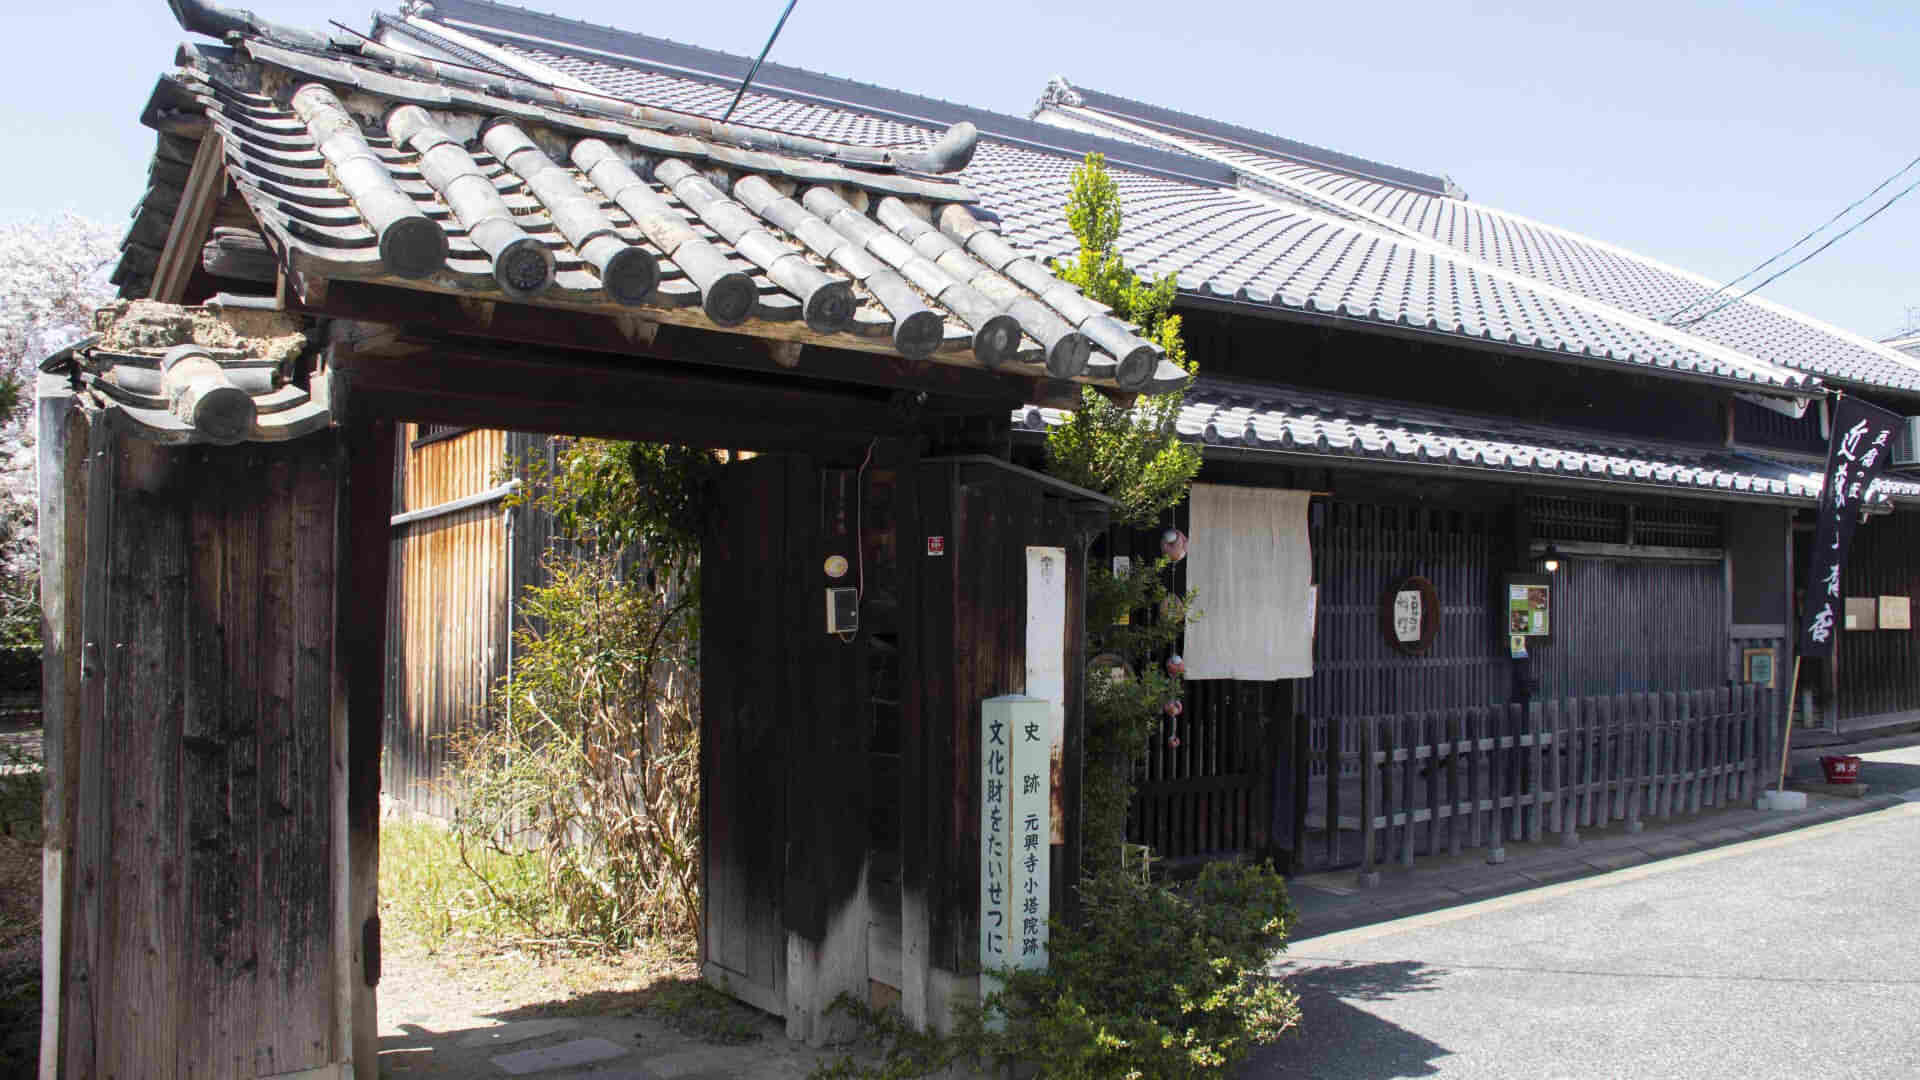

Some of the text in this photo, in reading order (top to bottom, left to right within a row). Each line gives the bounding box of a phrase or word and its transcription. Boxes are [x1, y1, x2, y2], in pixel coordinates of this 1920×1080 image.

[987, 720, 1004, 954] 文化財をたいせつに
